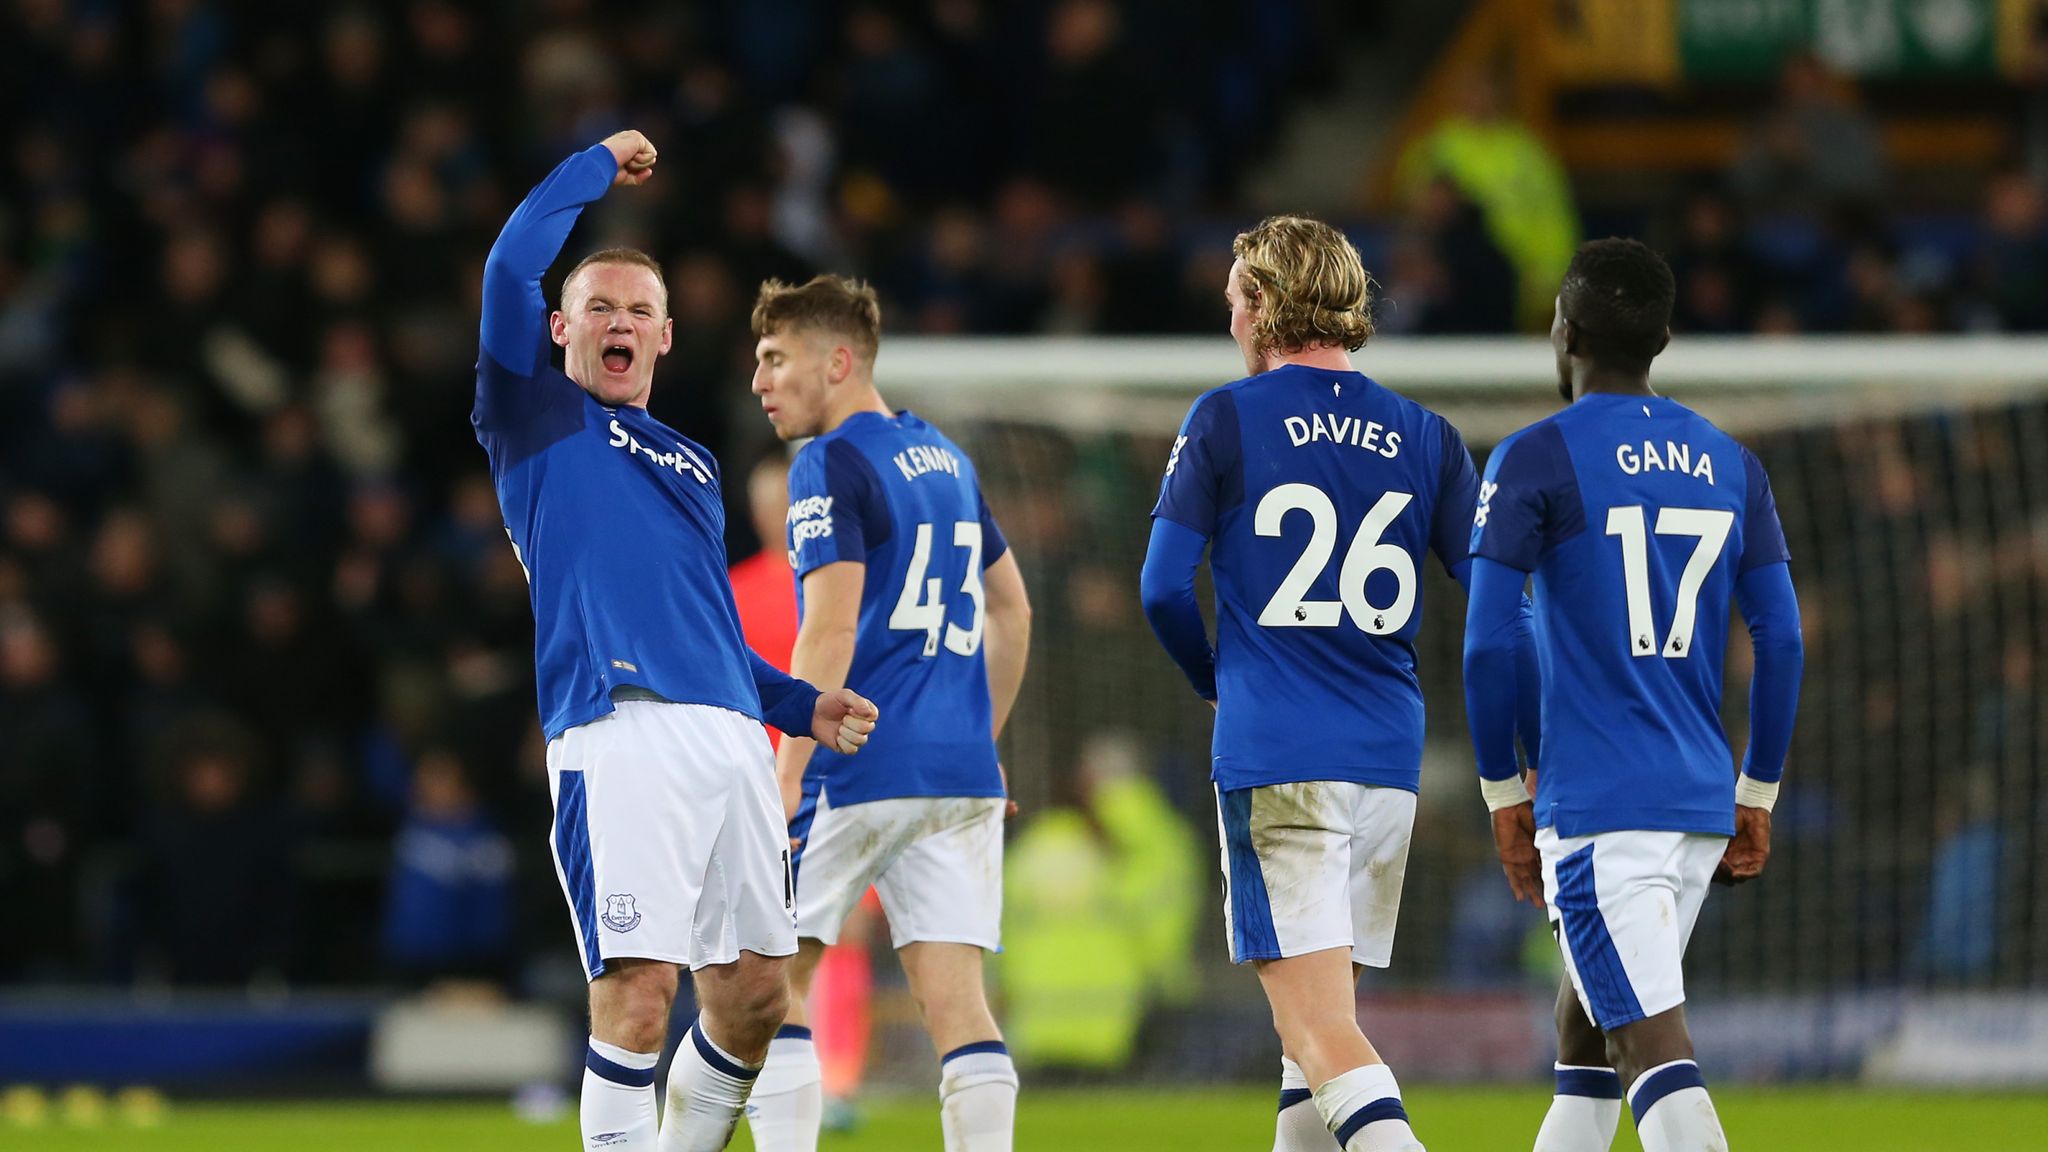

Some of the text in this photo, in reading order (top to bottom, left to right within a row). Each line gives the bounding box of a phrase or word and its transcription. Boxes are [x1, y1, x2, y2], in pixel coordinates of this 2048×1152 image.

[893, 445, 960, 481] KENNY
[1284, 413, 1402, 458] DAVIES
[1616, 441, 1714, 486] GANA
[888, 521, 985, 657] 43
[1254, 483, 1417, 635] 26
[1605, 505, 1735, 658] 17
